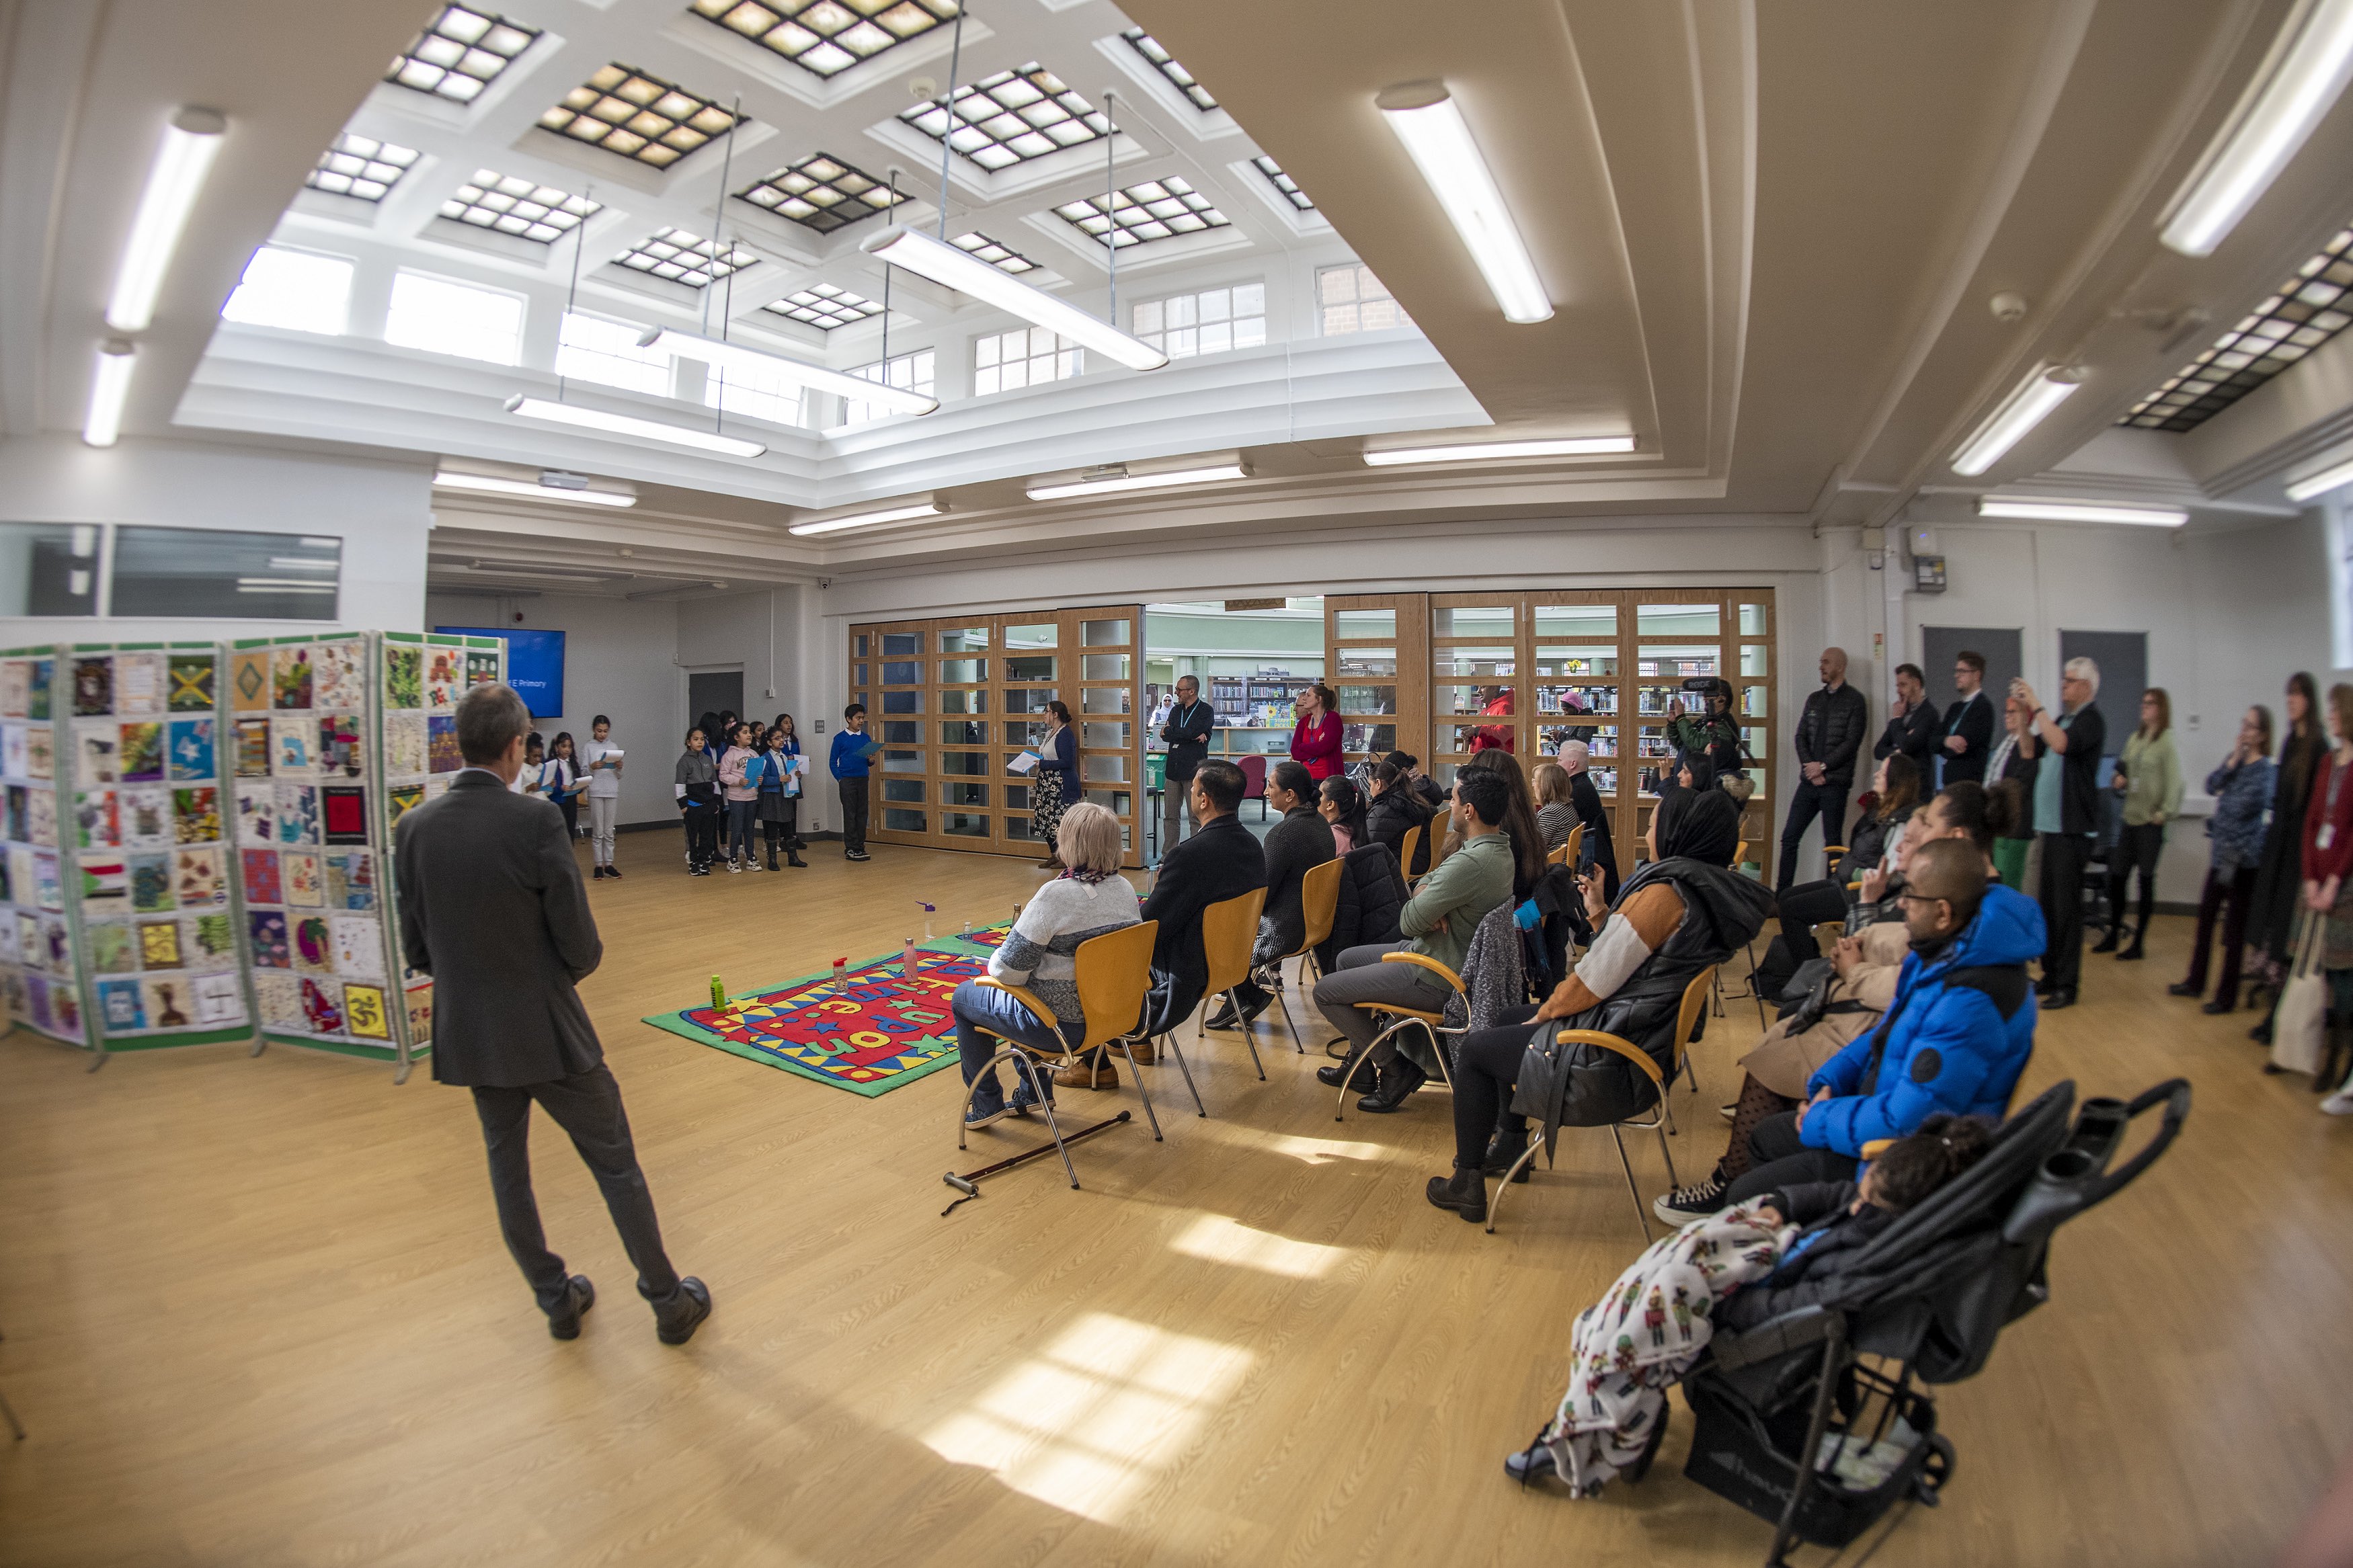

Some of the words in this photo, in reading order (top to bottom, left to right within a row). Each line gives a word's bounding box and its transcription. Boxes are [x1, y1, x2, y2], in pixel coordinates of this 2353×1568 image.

[512, 679, 518, 687] E
[518, 679, 547, 689] Primary
[805, 1010, 947, 1057] upon
